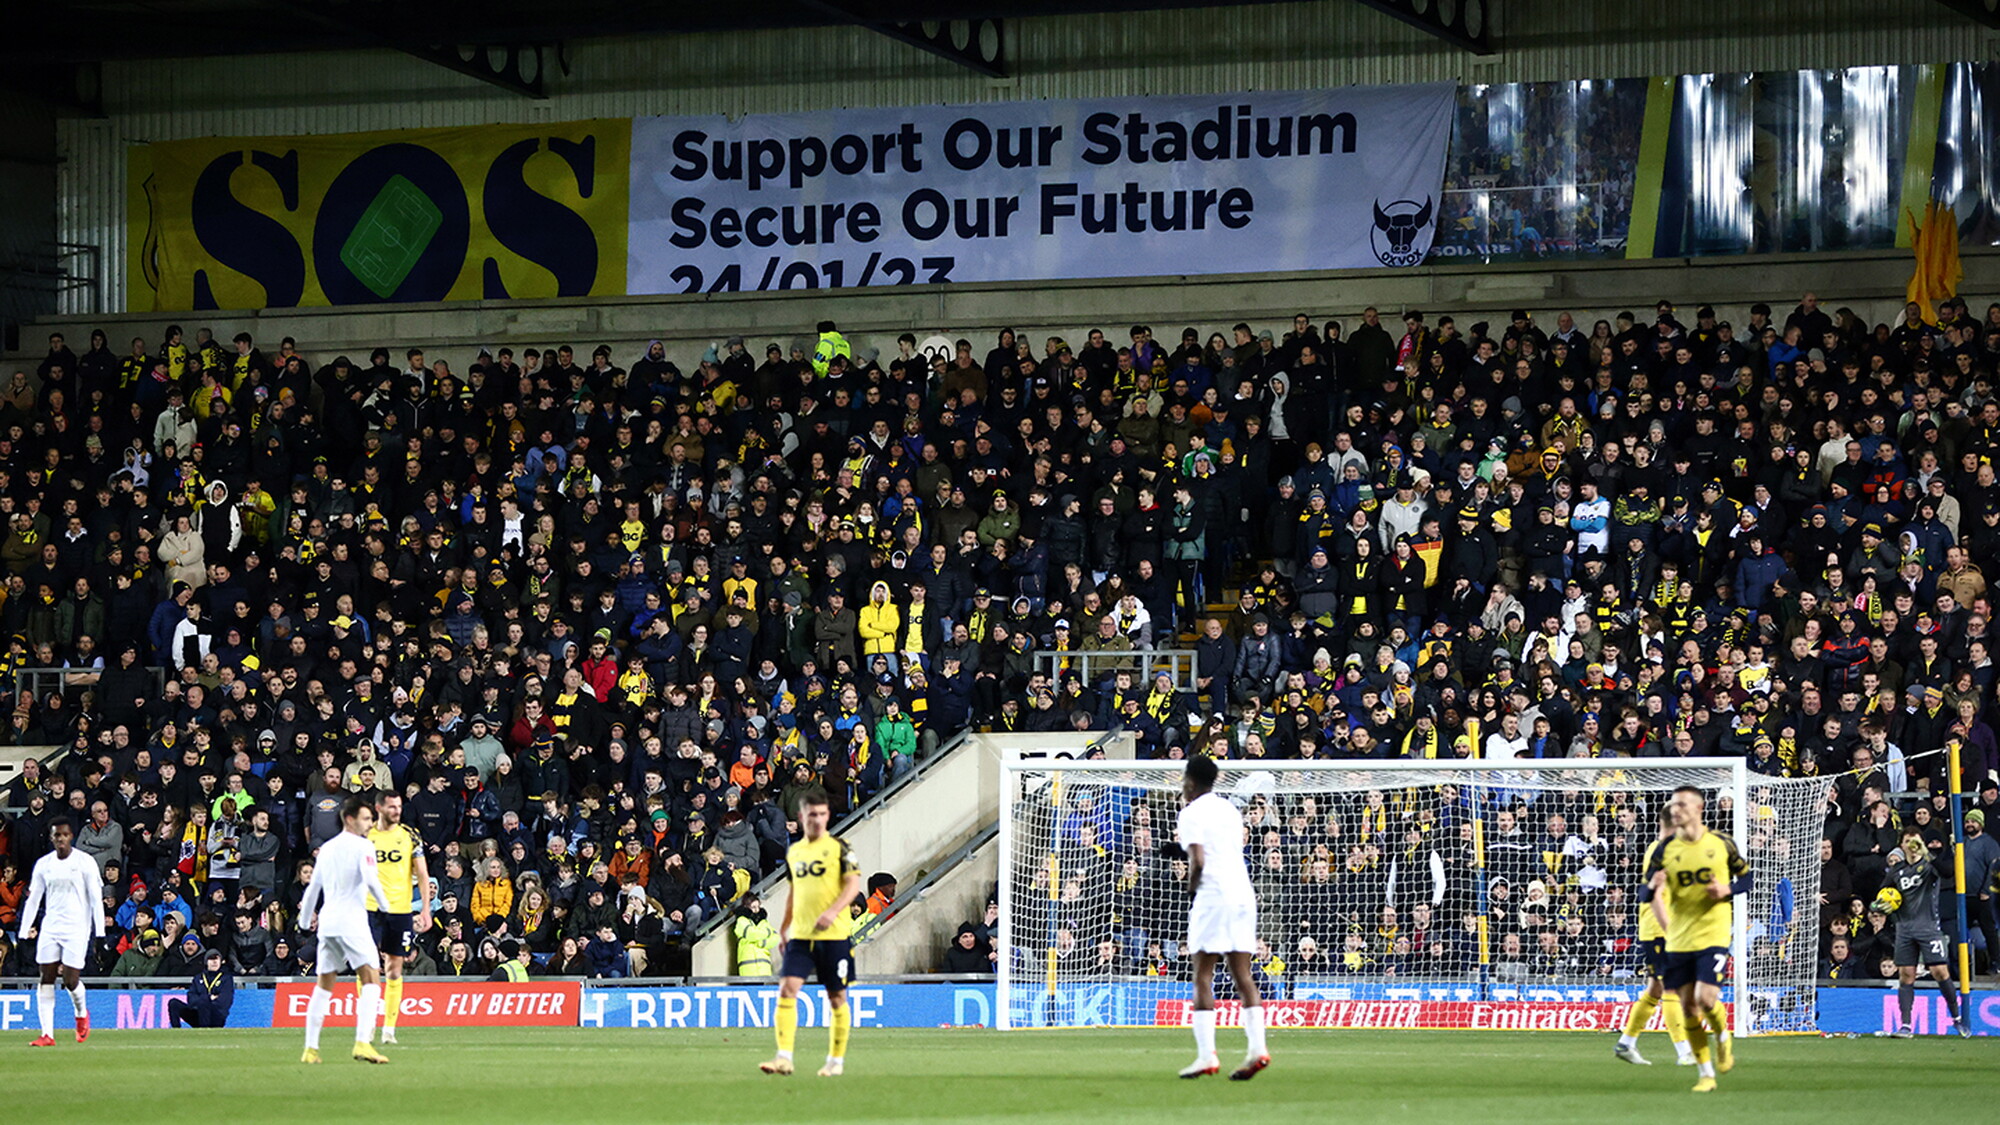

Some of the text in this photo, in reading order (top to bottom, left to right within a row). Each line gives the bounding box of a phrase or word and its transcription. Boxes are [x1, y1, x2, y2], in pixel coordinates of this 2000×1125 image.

[670, 104, 1358, 191] Support Our Stadium
[191, 134, 598, 311] SOS
[669, 182, 1254, 249] Secure Our Future
[670, 252, 955, 294] 24/01/23
[376, 850, 402, 863] BG
[796, 860, 826, 878] BG
[1677, 867, 1713, 887] BG
[1900, 875, 1923, 890] BG
[401, 931, 411, 946] 5
[837, 959, 849, 978] 8
[1713, 954, 1727, 973] 7
[288, 993, 565, 1016] Emies FLY BETTER
[1316, 1003, 1351, 1027] FLY
[1351, 1003, 1421, 1027] BETTER
[1471, 1003, 1599, 1029] Emirates
